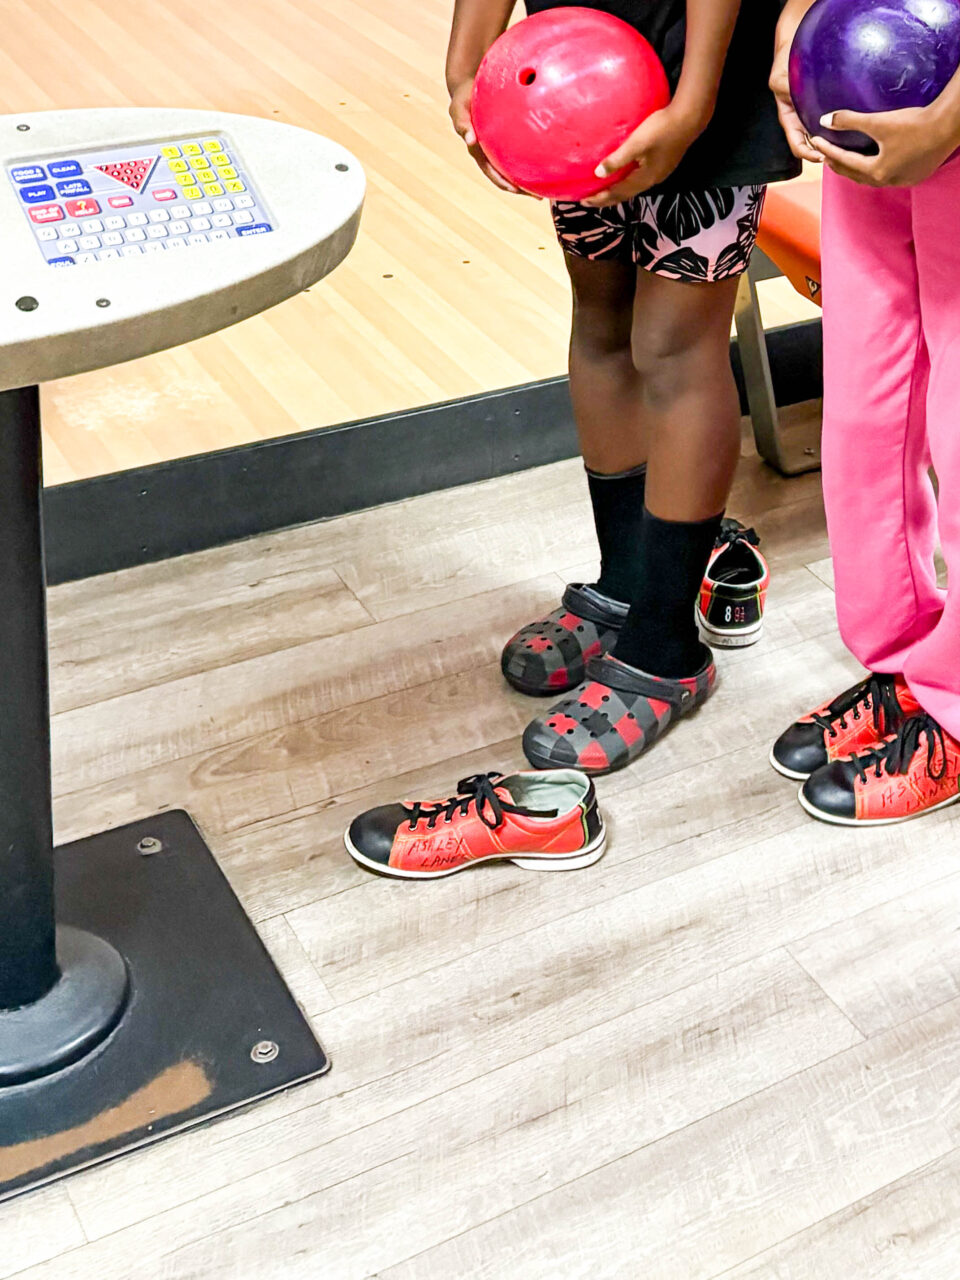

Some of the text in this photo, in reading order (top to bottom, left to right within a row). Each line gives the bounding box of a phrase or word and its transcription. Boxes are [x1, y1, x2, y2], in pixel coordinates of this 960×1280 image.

[52, 165, 77, 173] CLEAR
[77, 200, 87, 210] ?
[241, 226, 267, 236] ENTER
[725, 605, 732, 623] 8
[408, 832, 463, 856] ASHLEY
